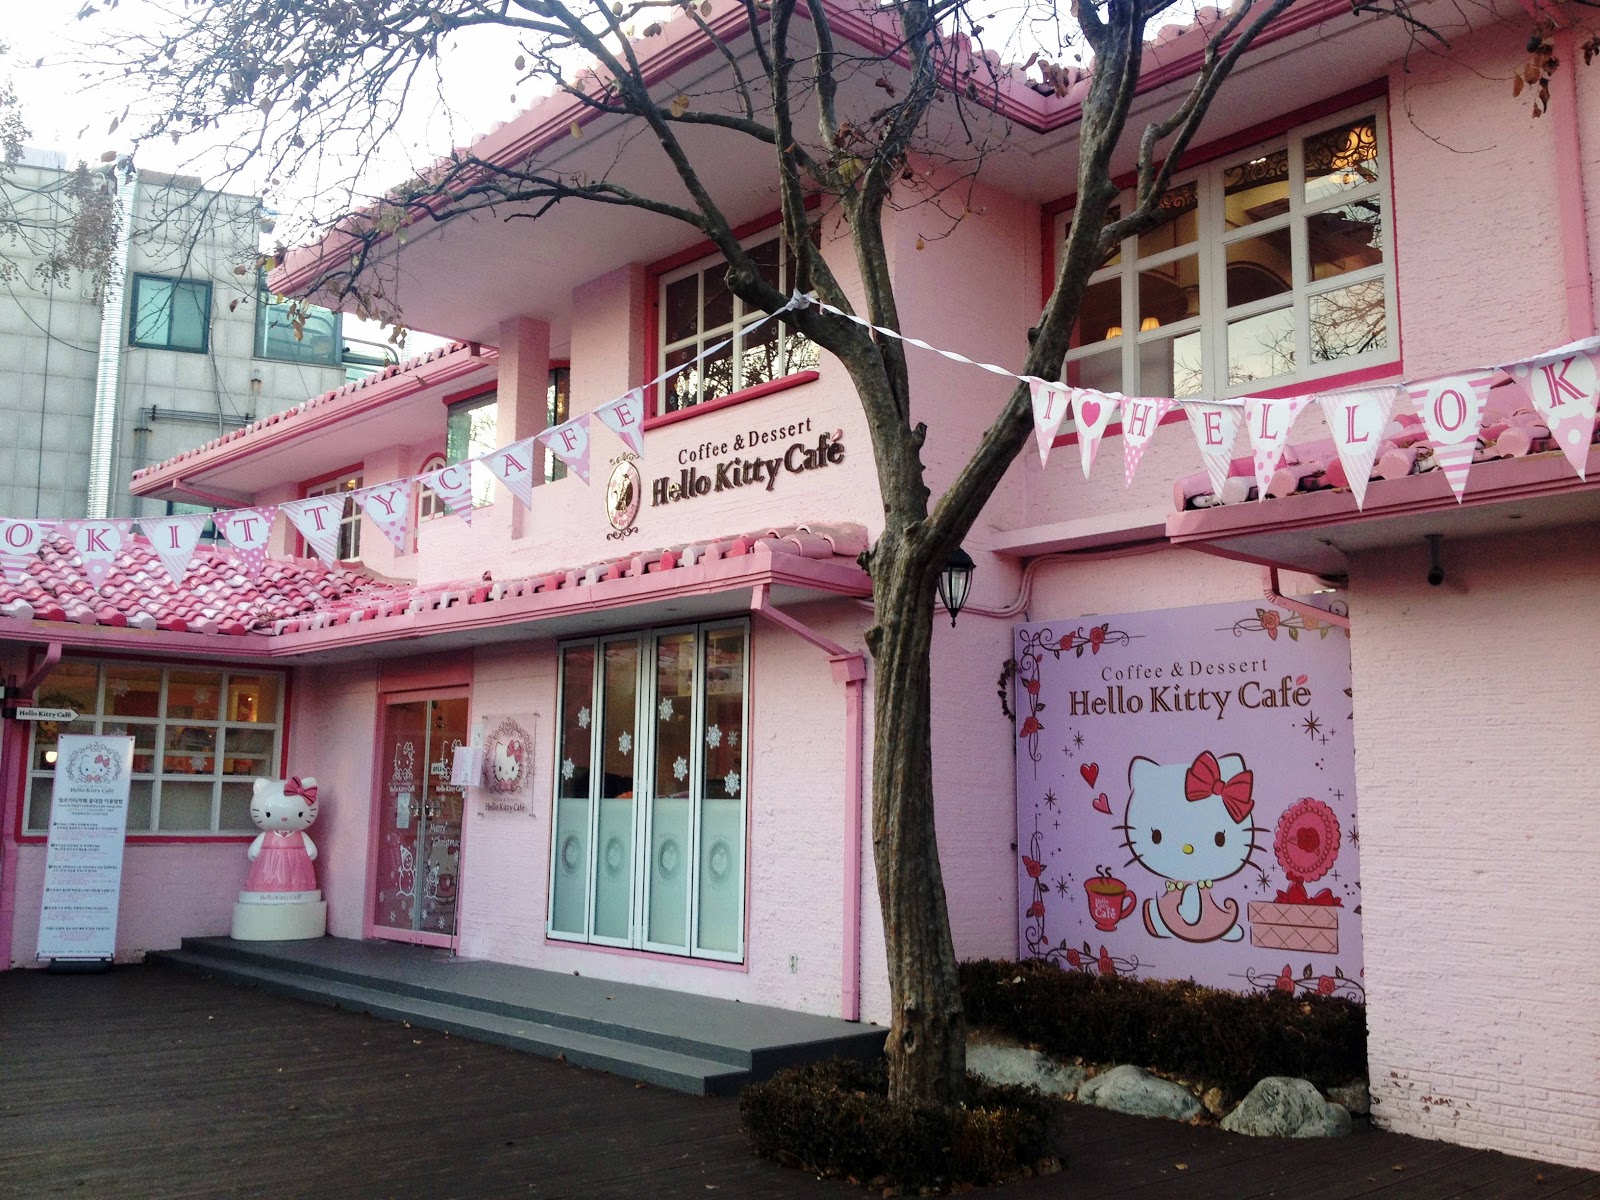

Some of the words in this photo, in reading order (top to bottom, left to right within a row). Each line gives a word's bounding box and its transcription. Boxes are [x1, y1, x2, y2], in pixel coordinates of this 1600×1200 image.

[678, 441, 728, 465] Coffee
[733, 434, 745, 451] &
[748, 417, 812, 448] Dessert
[650, 467, 712, 507] Hello
[713, 456, 783, 492] Kitty
[783, 428, 846, 475] Café
[1101, 664, 1163, 682] Coffee
[1170, 662, 1184, 677] &
[1189, 658, 1268, 677] Dessert
[1068, 685, 1144, 716] Hello
[1149, 683, 1233, 720] Kitty
[1238, 674, 1312, 709] Café
[39, 711, 56, 719] Kitty
[485, 802, 499, 811] Hello
[499, 802, 512, 814] Kitty
[1095, 907, 1117, 920] Café
